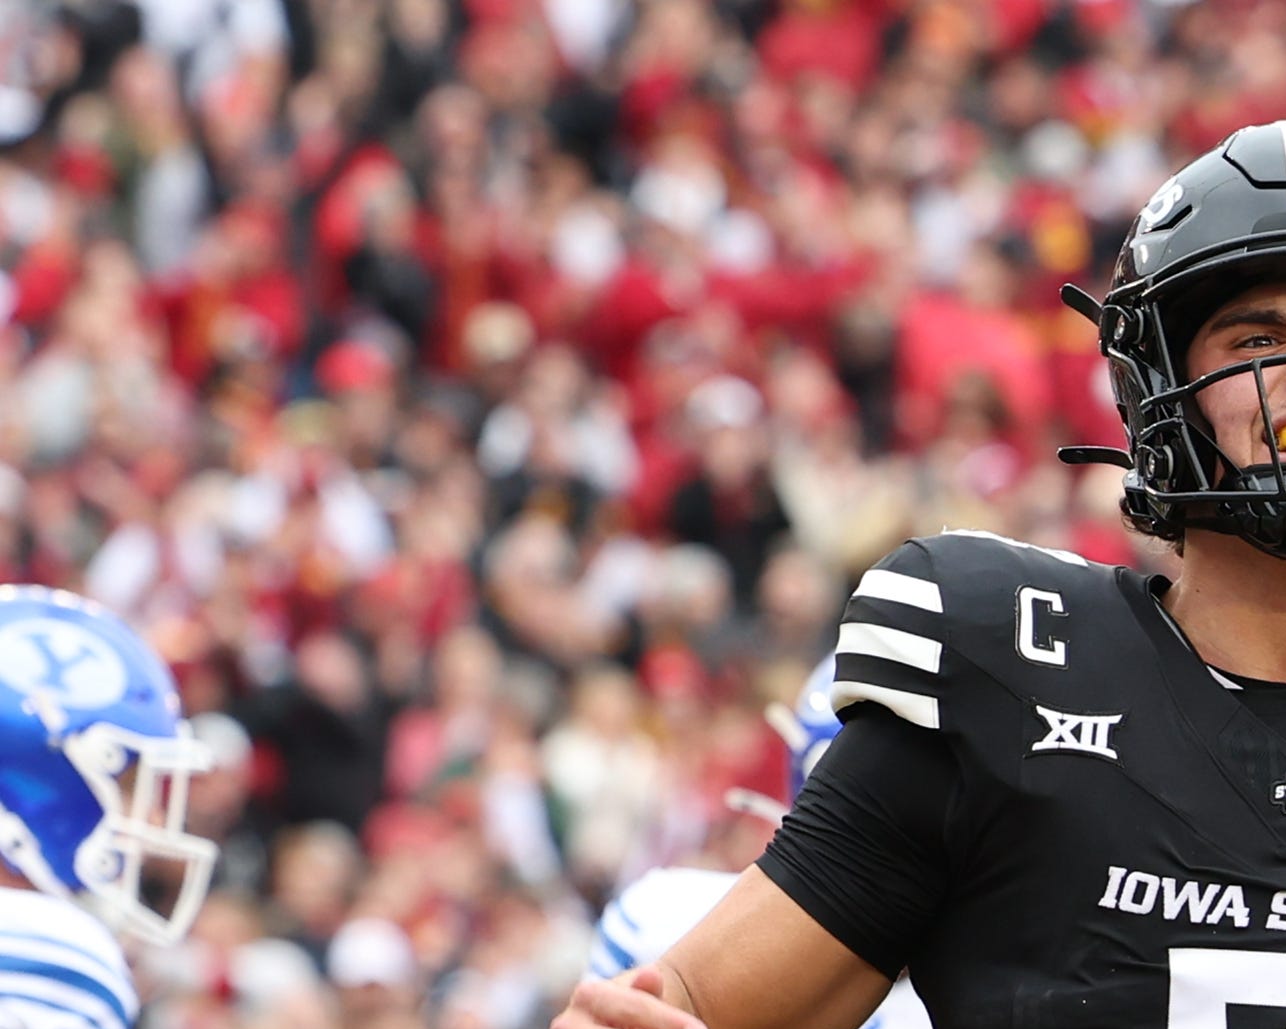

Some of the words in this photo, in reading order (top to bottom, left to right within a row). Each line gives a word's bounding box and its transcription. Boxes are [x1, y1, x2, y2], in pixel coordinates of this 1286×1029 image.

[1018, 585, 1067, 667] C
[22, 632, 99, 694] Y
[1031, 704, 1124, 761] XII
[1098, 866, 1251, 928] IOWA
